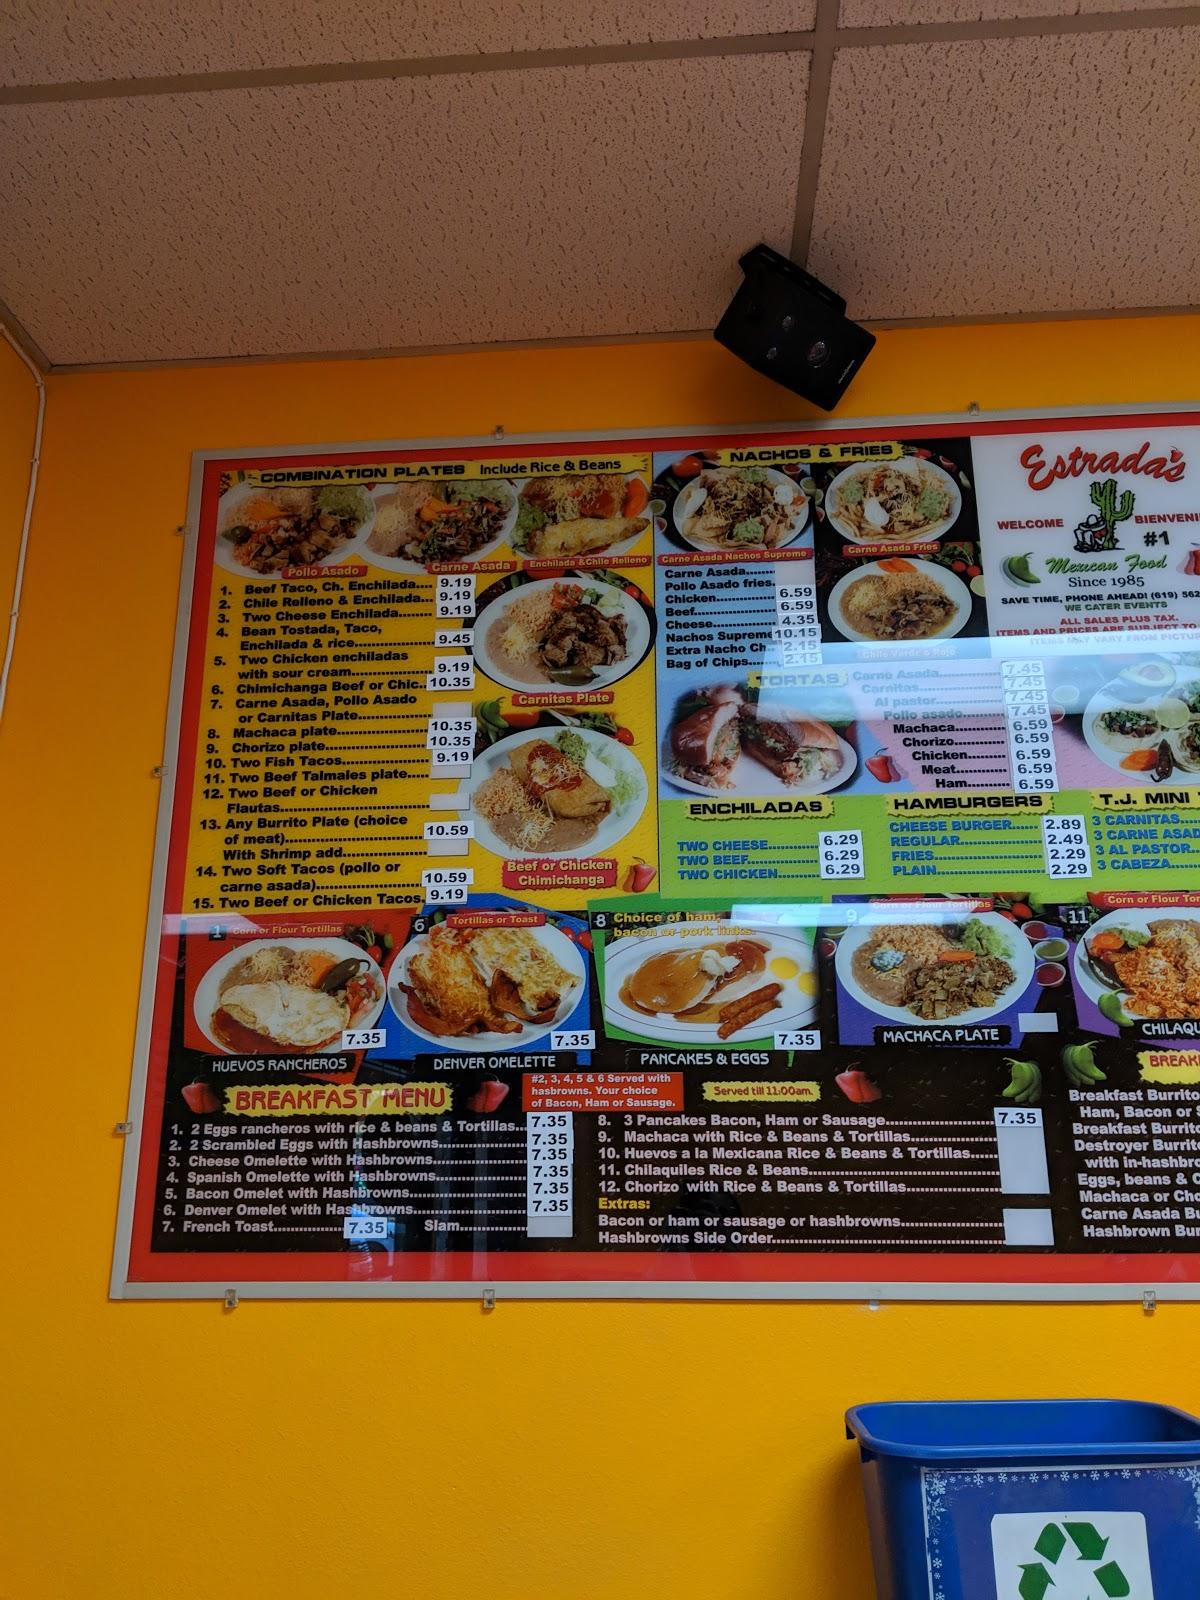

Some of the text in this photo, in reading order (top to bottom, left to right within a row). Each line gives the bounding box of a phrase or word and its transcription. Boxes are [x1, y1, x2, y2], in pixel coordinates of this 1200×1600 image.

[729, 445, 894, 463] NACHOS FRIES
[260, 459, 621, 483] COMBINATION PLATES Include Rice Beans
[1020, 442, 1186, 490] Estrada's
[997, 518, 1064, 530] WELCOME
[1143, 531, 1170, 547] #1
[848, 542, 938, 554] Carne Asada Fries
[661, 551, 807, 563] Carne Asada Nachos Supreme
[431, 561, 511, 573] Carne Asada
[1045, 554, 1167, 575] Mexican Food
[288, 565, 359, 578] Pollo Asado
[440, 577, 472, 588] 9.19
[1068, 576, 1145, 588] Since 1985
[245, 583, 317, 595] Beef Taco,
[779, 587, 813, 598] 6.59
[243, 595, 334, 609] Chile Relleno
[1001, 591, 1178, 605] SAVE TIME, PHONE AHEAD! (619)
[1084, 601, 1168, 611] CATER EVENTS
[275, 610, 326, 622] Cheese
[782, 614, 815, 626] 4.35
[1083, 616, 1119, 625] SALES
[1123, 615, 1150, 623] PLUS
[1154, 614, 1179, 622] TAX.
[241, 623, 341, 637] Bean Tostada,
[774, 628, 817, 639] 10.15
[438, 633, 471, 644] 9.45
[239, 650, 409, 666] Two Chicken enchiladas
[429, 677, 471, 688] 10.35
[756, 673, 840, 685] TORTAS
[236, 680, 365, 696] Chimichanga Beef
[235, 694, 417, 710] Carne Pollo Asado
[518, 693, 610, 705] Carnitas Plate
[1011, 704, 1047, 716] 7.45
[257, 711, 318, 723] Carnitas
[1013, 719, 1048, 730] 6.59
[233, 727, 297, 739] Machaca
[231, 741, 287, 753] Chorizo
[265, 756, 295, 767] Fish
[263, 769, 367, 782] Beef Talmales
[893, 795, 1043, 810] HAMBURGERS
[1099, 792, 1190, 805] T.J. MINI
[689, 800, 823, 815] ENCHILADAS
[257, 816, 350, 828] Burrito Plate
[1045, 819, 1081, 830] 2.89
[426, 825, 469, 836] 10.59
[823, 834, 859, 846] 6.29
[260, 847, 311, 861] Shrimp
[256, 863, 334, 875] Soft Tacos
[507, 860, 613, 872] Beef Chicken
[518, 874, 605, 887] Chimichanga
[313, 894, 372, 906] Chicken
[430, 889, 464, 900] 9.19
[452, 915, 538, 925] Tortillas Toast
[613, 913, 662, 924] Choice
[272, 924, 342, 934] Flour Tortillas
[613, 926, 712, 938] bacon pork
[346, 1032, 381, 1045] 7.35
[555, 1034, 590, 1046] 7.35
[778, 1034, 815, 1046] 7.35
[883, 1029, 1000, 1043] MACHACA PLATE
[212, 1057, 348, 1073] HUEVOS RANCHEROS
[433, 1055, 557, 1070] DENVER OMELETTE
[640, 1053, 770, 1066] PANCAKES EGGS
[607, 1074, 644, 1083] Served
[531, 1085, 658, 1096] hasbrowns. Your choice
[714, 1085, 749, 1097] Served
[1068, 1089, 1144, 1102] Breakfast
[235, 1086, 446, 1110] BREAKFAST MENU
[545, 1098, 676, 1109] Bacon, Ham Sausage.
[997, 1112, 1037, 1125] 7.35
[1079, 1105, 1173, 1120] Ham, Bacon
[531, 1115, 567, 1128] 7.35
[637, 1114, 761, 1128] Pancakes Bacon,
[204, 1123, 310, 1137] Eggs rancheros
[1072, 1122, 1148, 1135] Breakfast
[624, 1131, 689, 1143] Machaca
[202, 1139, 275, 1151] Scrambled
[1073, 1139, 1150, 1154] Destroyer
[624, 1147, 783, 1159] Huevos Mexicana
[188, 1155, 308, 1167] Cheese Omelette
[624, 1163, 706, 1178] Chilaquiles
[186, 1171, 242, 1185] Spanish
[1077, 1172, 1172, 1188] Eggs, beans
[185, 1187, 284, 1200] Bacon Omelet
[624, 1181, 680, 1194] Chorizo
[1079, 1190, 1150, 1203] Machaca
[598, 1197, 651, 1210] Extras:
[184, 1204, 287, 1217] Denver Omelet
[1080, 1206, 1181, 1220] Carne Asada
[183, 1220, 231, 1233] French
[348, 1222, 385, 1235] 7.35
[598, 1215, 786, 1230] Bacon sausage
[1082, 1224, 1171, 1238] Hashbrown
[598, 1231, 690, 1245] Hashbrowns
